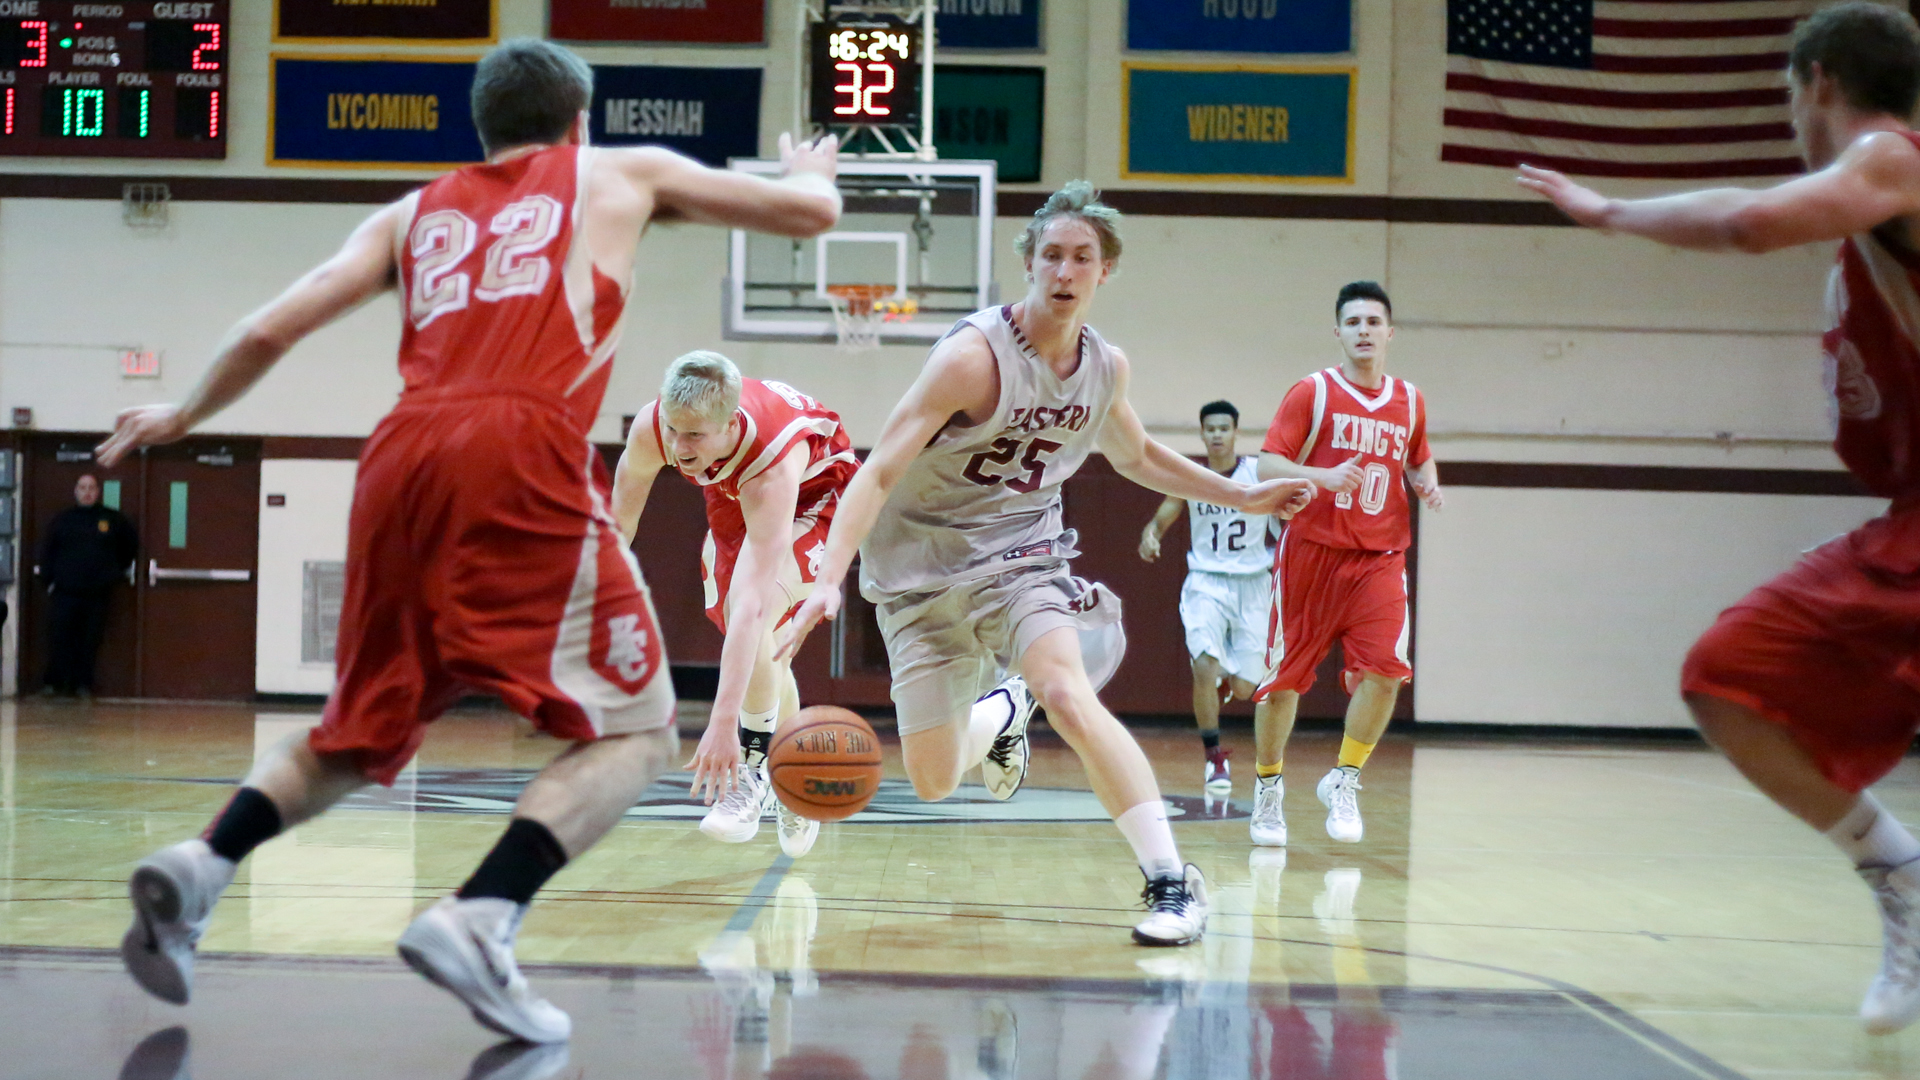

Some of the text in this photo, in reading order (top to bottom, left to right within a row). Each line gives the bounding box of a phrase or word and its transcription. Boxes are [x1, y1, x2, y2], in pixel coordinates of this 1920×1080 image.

[72, 4, 124, 17] PERIOD
[153, 3, 214, 19] GUEST
[72, 52, 120, 67] BONUS
[192, 23, 220, 70] 2
[829, 30, 909, 62] 16:24
[48, 72, 100, 85] PLAYER
[117, 72, 151, 85] FOUL
[176, 73, 221, 87] FOULS
[833, 62, 895, 116] 32
[5, 88, 15, 134] 1
[62, 88, 104, 136] 10
[139, 89, 149, 138] 1
[209, 91, 219, 138] 1
[327, 93, 439, 131] LYCOMING
[605, 98, 703, 136] MESSIAH
[1186, 104, 1289, 143] WIDENER
[410, 194, 564, 332] 22
[1007, 405, 1091, 433] EASTERN
[1331, 412, 1407, 461] KING'S
[961, 436, 1064, 495] 25
[1211, 519, 1246, 552] 12
[803, 778, 856, 796] MAC
